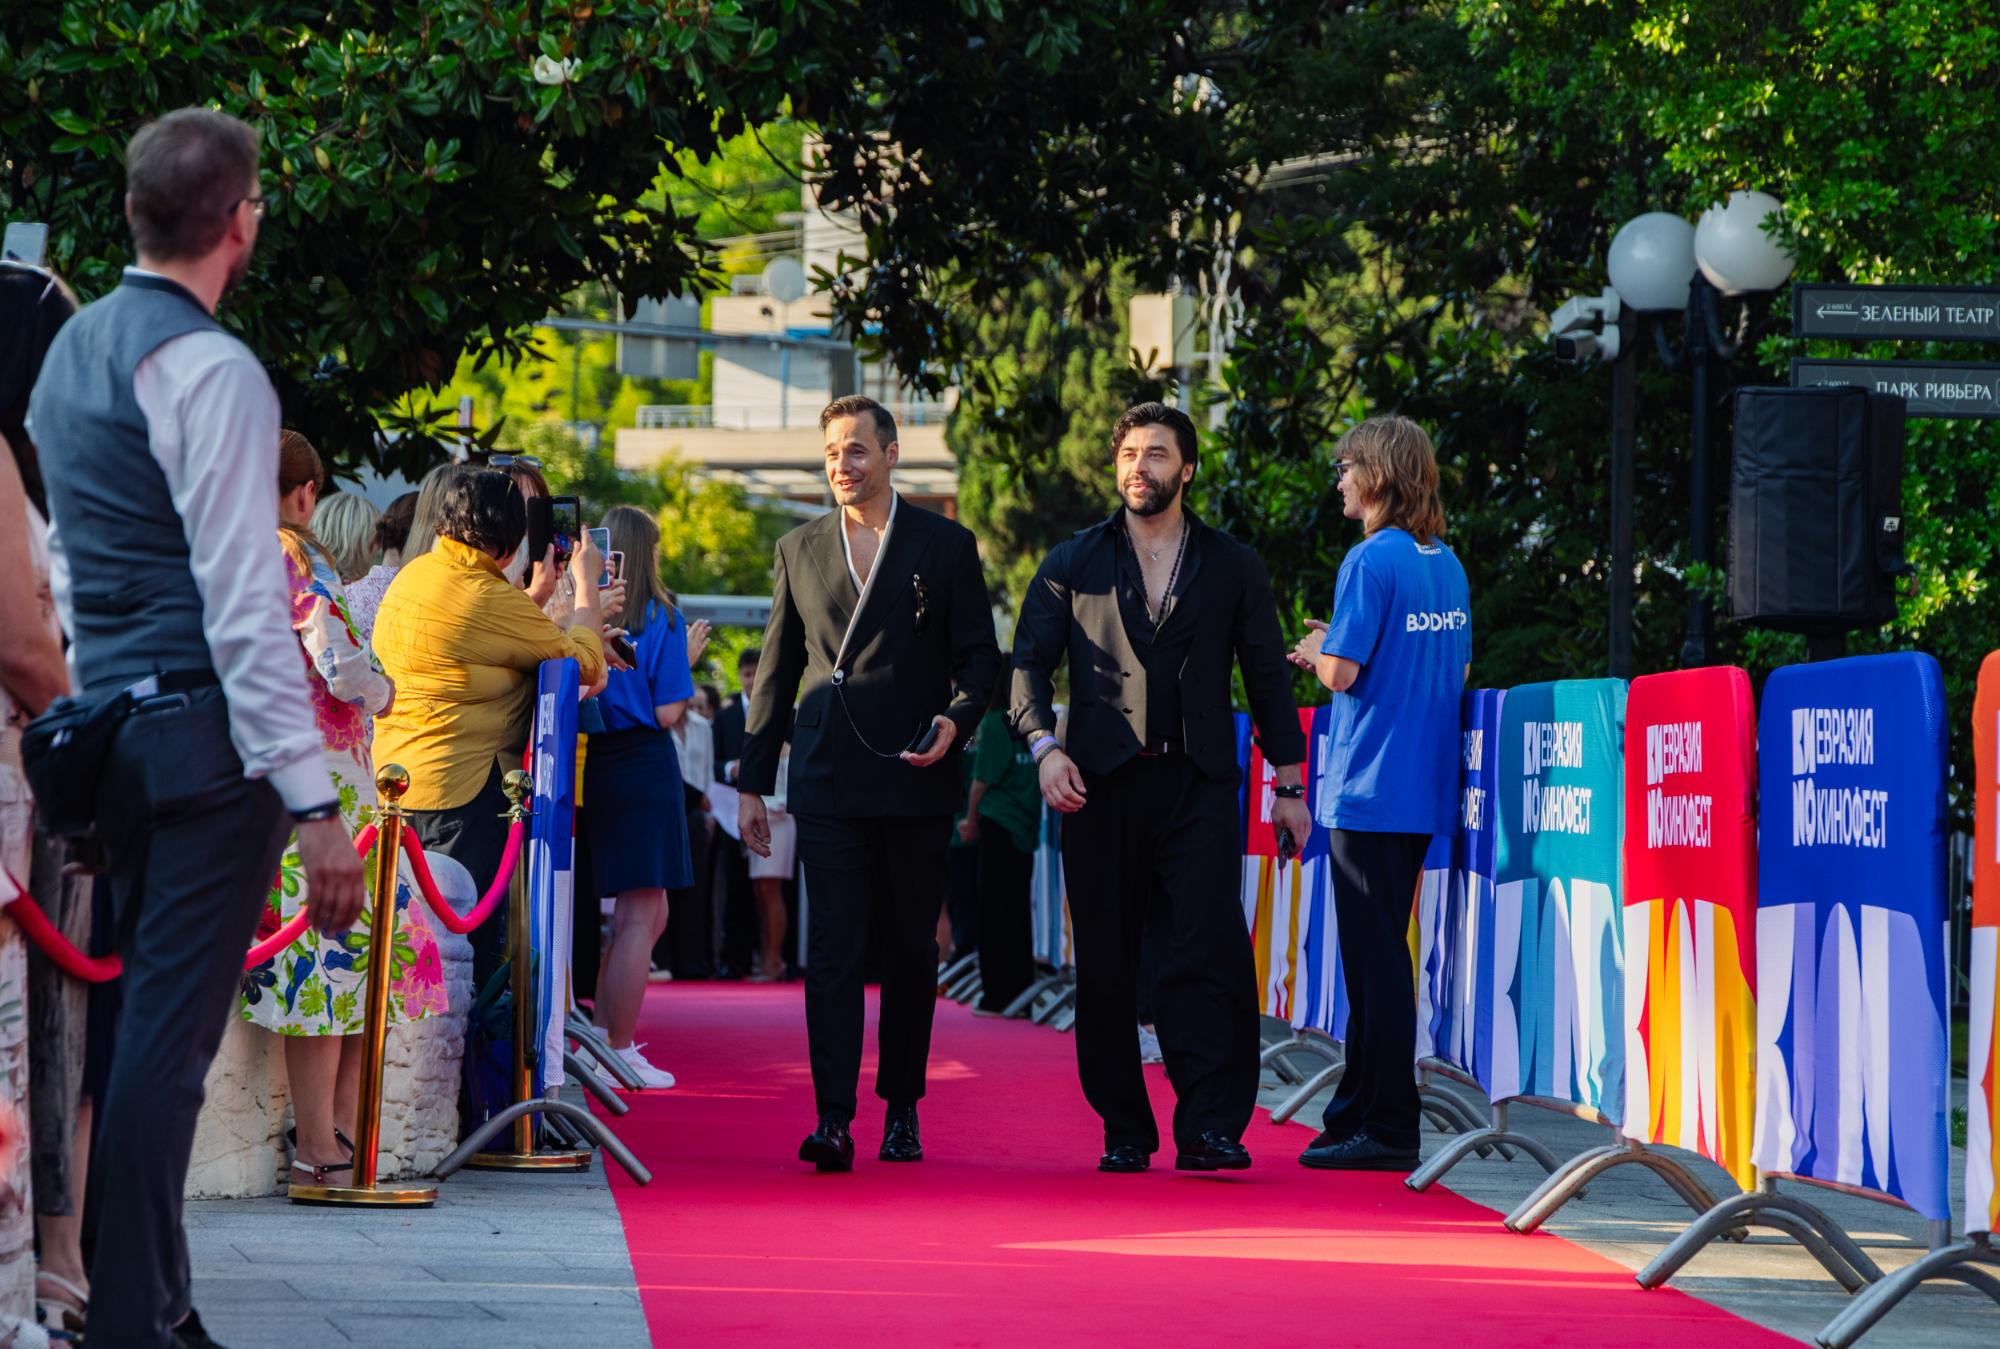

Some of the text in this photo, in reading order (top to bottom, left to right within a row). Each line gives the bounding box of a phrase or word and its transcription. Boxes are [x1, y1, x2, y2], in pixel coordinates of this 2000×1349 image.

[1861, 305, 1994, 324] ЗЕЛЕНЫЙ ТЕАТР
[1876, 381, 1992, 400] ПАРК РИВЬЕРА
[1541, 721, 1582, 768] ЕВРАЗИЯ
[1663, 721, 1702, 774] ЕВРАЗИЯ
[1816, 708, 1874, 765] ЕВРАЗИЯ
[1541, 784, 1592, 835] КИНОФЕСТ
[1664, 793, 1712, 848] КИНОФЕСТ
[1817, 786, 1888, 849] КИНОФЕСТ
